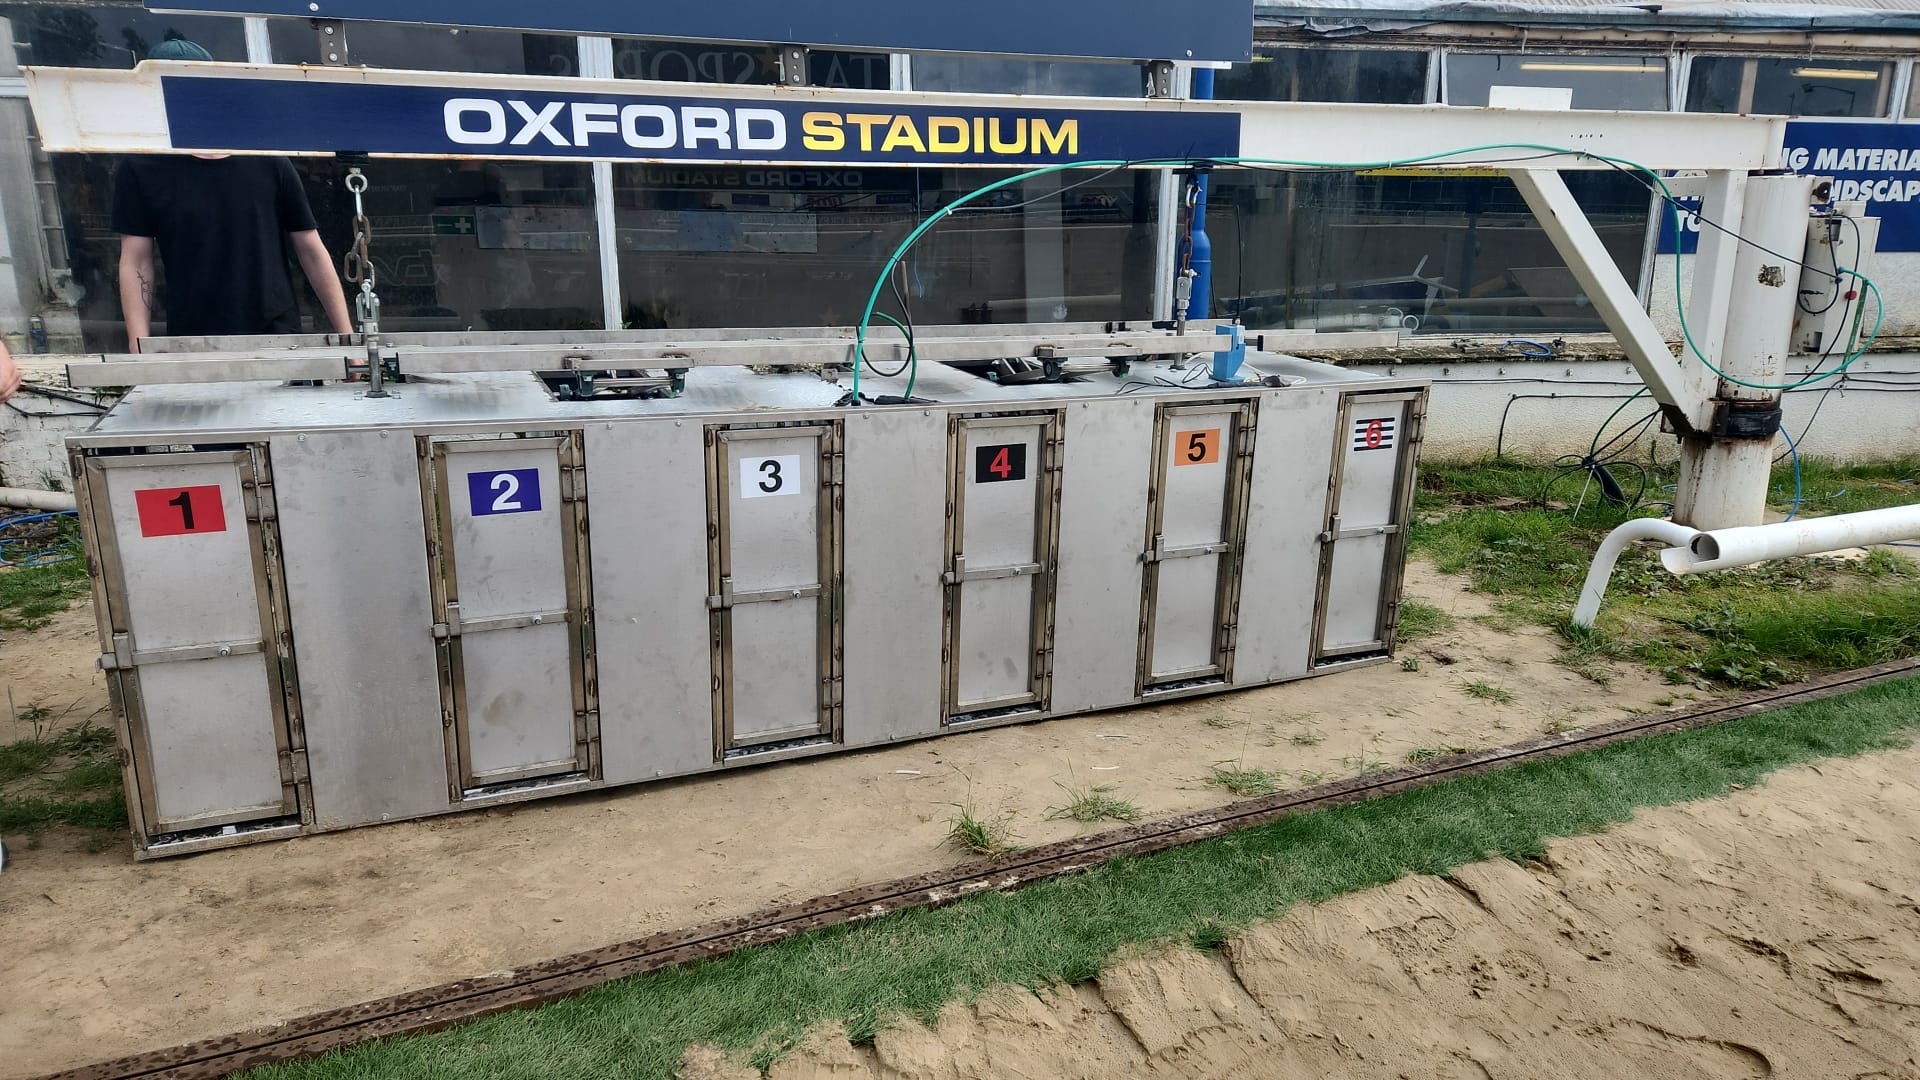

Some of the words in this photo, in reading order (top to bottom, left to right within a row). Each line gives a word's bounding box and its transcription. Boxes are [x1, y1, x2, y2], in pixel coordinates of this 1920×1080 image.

[443, 98, 787, 151] OXFORD
[802, 112, 1079, 155] STADIUM
[1187, 432, 1207, 462] 5
[1365, 419, 1383, 448] 6
[758, 459, 783, 493] 3
[990, 447, 1012, 478] 4
[490, 473, 522, 511] 2
[168, 491, 195, 530] 1
